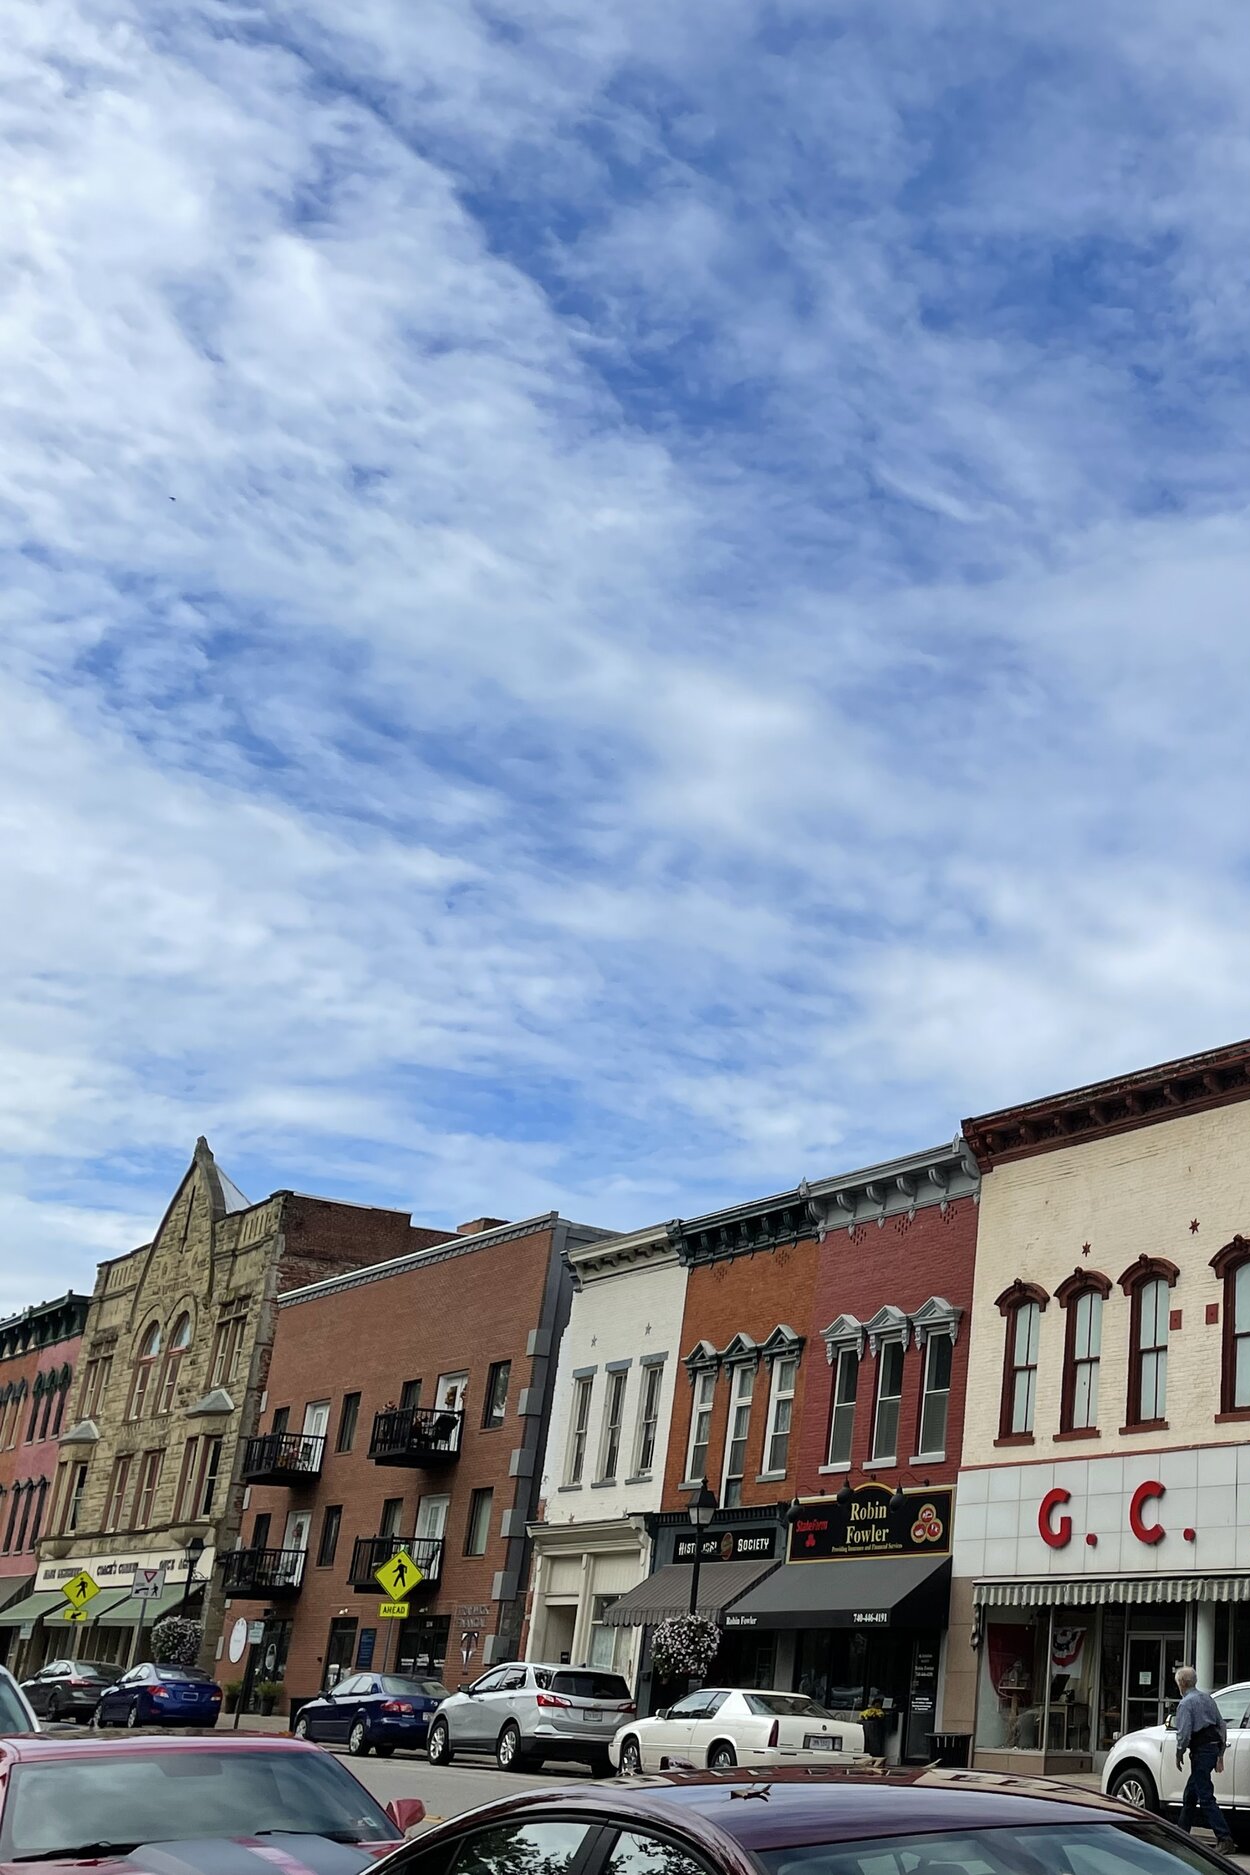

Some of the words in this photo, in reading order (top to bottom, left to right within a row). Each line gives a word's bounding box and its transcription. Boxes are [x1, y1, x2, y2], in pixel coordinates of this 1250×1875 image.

[850, 1501, 887, 1521] Robin
[846, 1524, 890, 1544] Fowler
[737, 1538, 770, 1552] SOCIETY
[382, 1605, 406, 1615] AHEAD
[726, 1616, 740, 1625] Robin
[740, 1616, 758, 1625] Fowler
